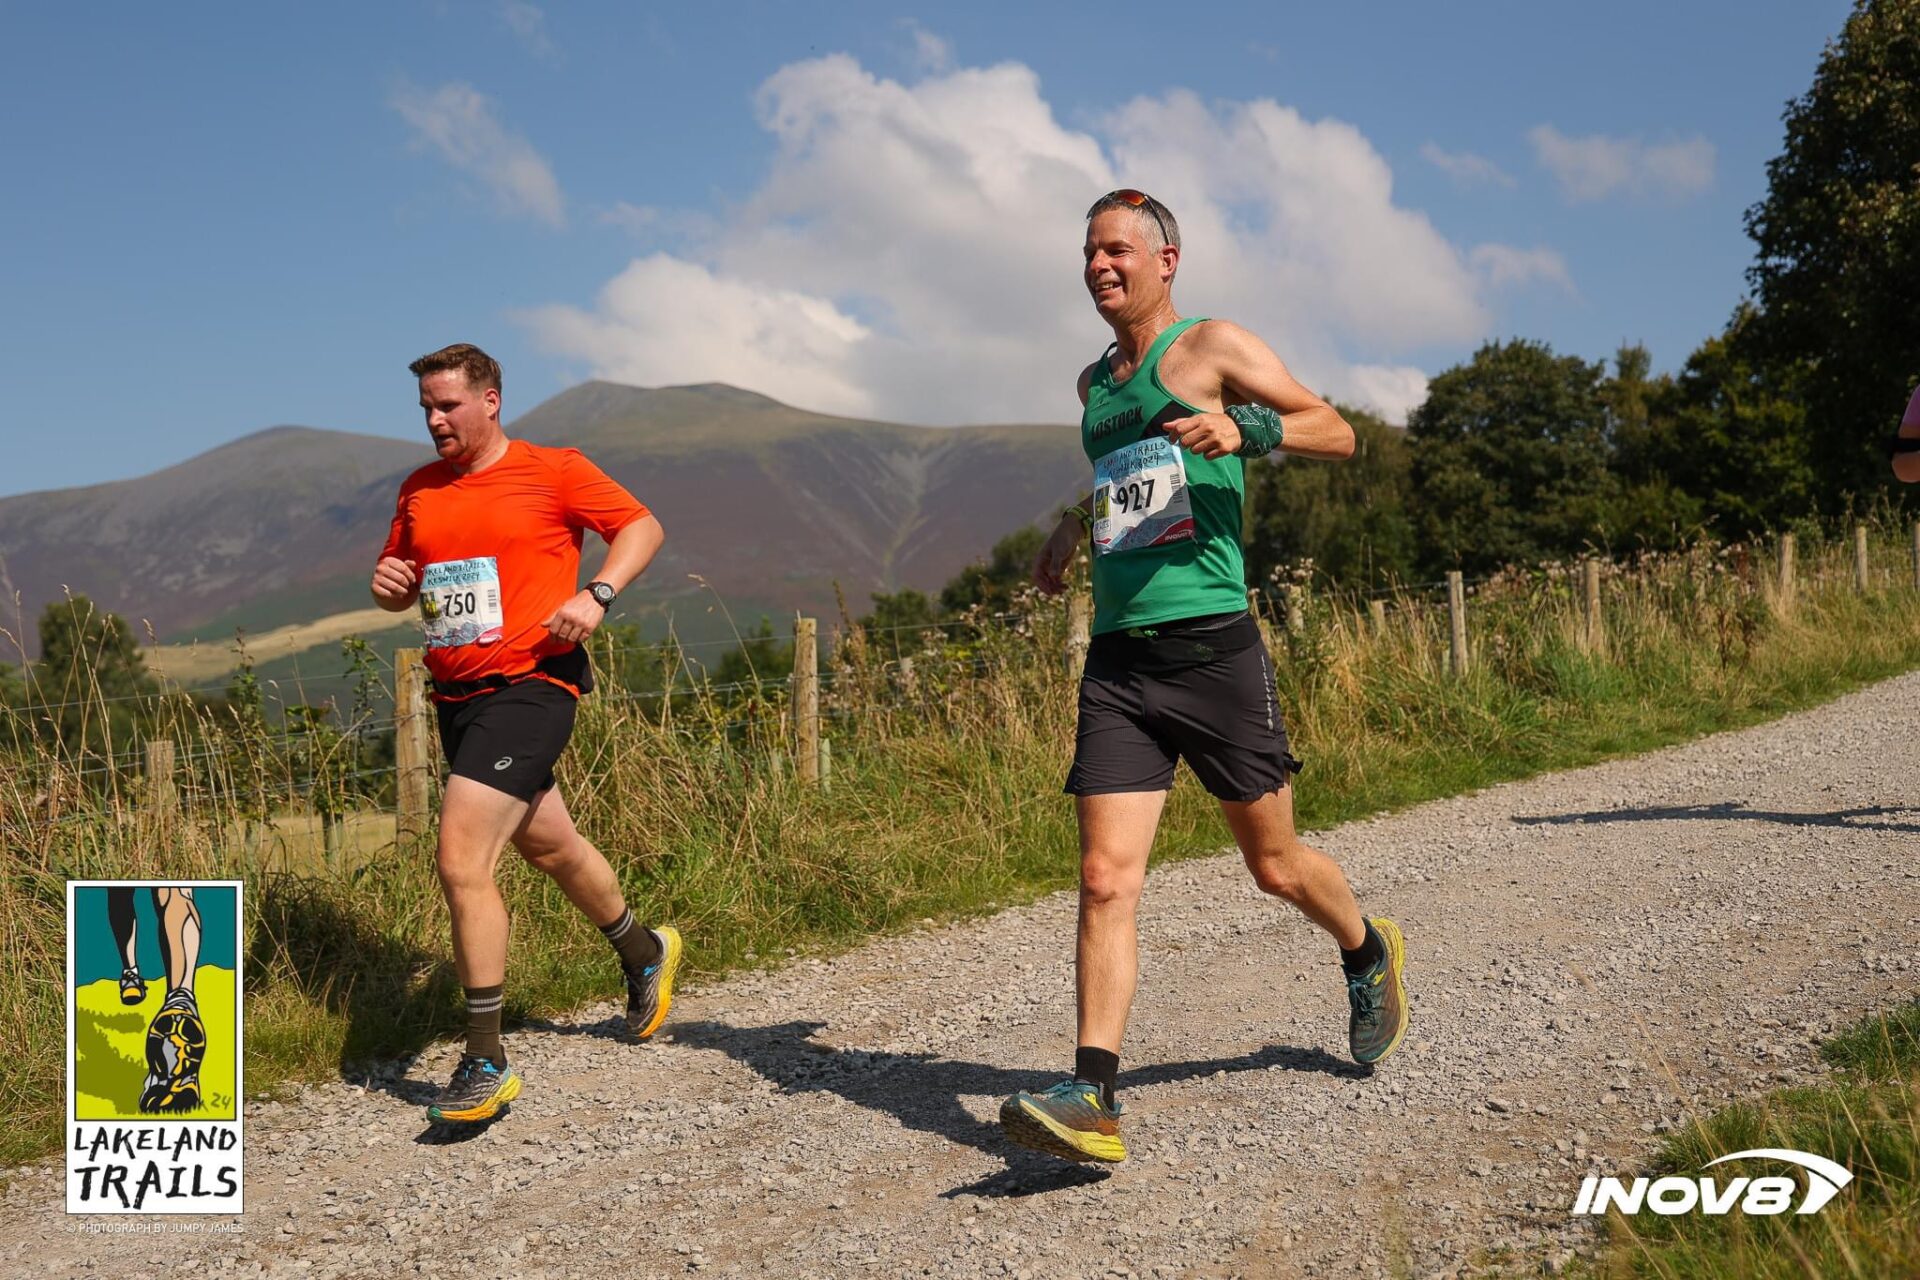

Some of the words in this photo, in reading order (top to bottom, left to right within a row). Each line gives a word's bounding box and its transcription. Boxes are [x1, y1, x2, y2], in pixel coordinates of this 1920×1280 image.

[1092, 405, 1144, 442] LOSTOCK
[1134, 441, 1166, 456] TRAILS
[1116, 478, 1155, 514] 927
[425, 564, 458, 577] AKELAND
[443, 592, 476, 617] 750
